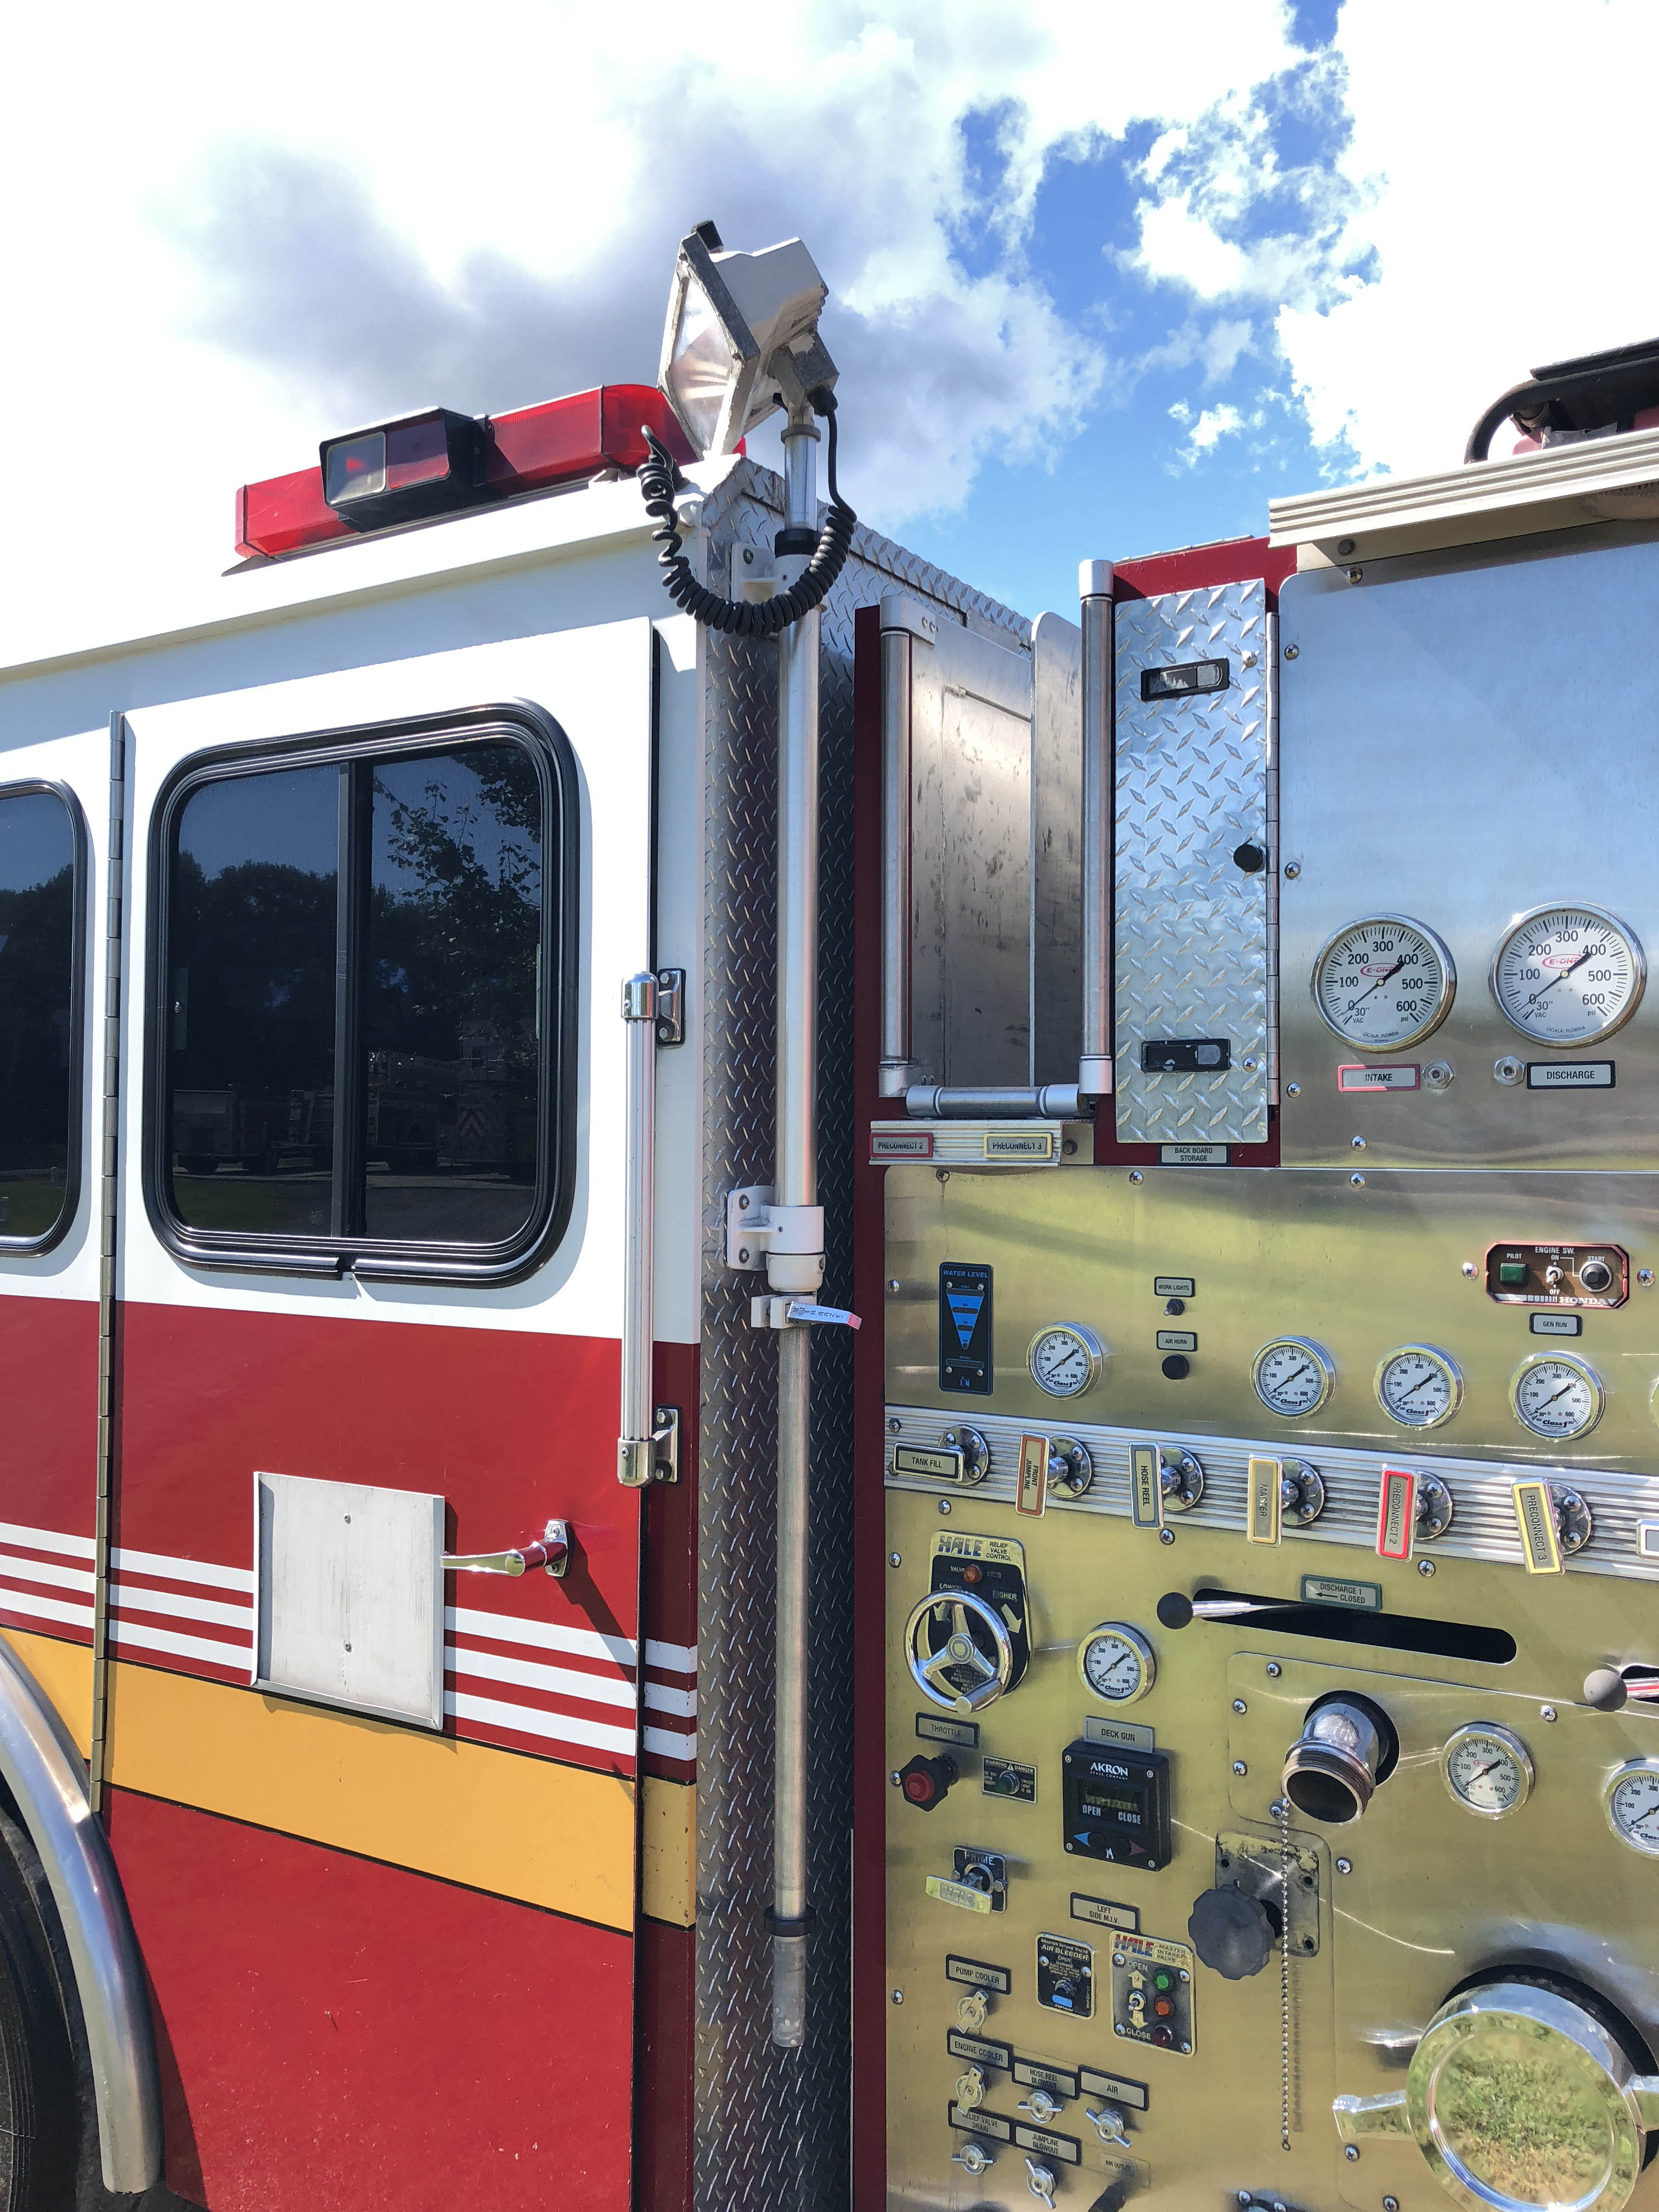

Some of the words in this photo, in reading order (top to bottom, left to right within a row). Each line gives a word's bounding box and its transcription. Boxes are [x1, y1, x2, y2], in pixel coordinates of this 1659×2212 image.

[1555, 930, 1578, 943] 300
[1372, 941, 1393, 952] 300
[1528, 944, 1551, 956] 200
[1583, 944, 1606, 956] 400
[1348, 953, 1369, 964] 200
[1397, 953, 1418, 965] 400
[1520, 969, 1540, 980] 100
[1588, 970, 1611, 982] 500
[1340, 977, 1358, 988] 100
[1402, 978, 1423, 989] 500
[1348, 1000, 1355, 1011] 0
[1529, 994, 1536, 1005] 0
[1582, 994, 1605, 1005] 600
[1396, 1001, 1417, 1012] 600
[1364, 1073, 1392, 1082] INTAKE
[1546, 1070, 1595, 1080] DISCHARGE
[1559, 1297, 1607, 1305] HONDA
[912, 1457, 928, 1466] TANK
[930, 1459, 942, 1468] FILL
[1141, 1465, 1149, 1486] HOSE
[1259, 1484, 1268, 1517] MASTER
[1390, 1483, 1401, 1537] PRECONNECT
[1527, 1496, 1545, 1550] PRECONNECT
[938, 1536, 983, 1556] HALE
[1320, 1583, 1357, 1594] DISCHARGE
[1340, 1594, 1365, 1604] CLOSED
[930, 1724, 962, 1737] THROTTLE
[1101, 1728, 1119, 1739] DECK
[1121, 1733, 1135, 1742] GUN
[985, 1759, 1007, 1768] WARNING
[1014, 1765, 1034, 1773] DANGER
[1090, 1762, 1128, 1776] AKRON
[1082, 1804, 1101, 1816] OPEN
[1118, 1812, 1141, 1825] CLOSE
[964, 1851, 995, 1865] PRIME
[1097, 1905, 1111, 1914] LEFT
[1089, 1911, 1102, 1920] SIDE
[1103, 1914, 1120, 1925] M.I.V.
[1114, 1934, 1154, 1957] HALE
[1159, 1944, 1186, 1954] MASTER
[1055, 1948, 1089, 1961] BLEEDER
[1156, 1954, 1177, 1963] VALVE
[1127, 1961, 1148, 1971] OPEN
[956, 1966, 973, 1977] PUMP
[975, 1972, 1000, 1984] COOLER
[1126, 2027, 1151, 2040] CLOSE
[955, 2041, 977, 2054] ENGINE
[979, 2049, 1003, 2062] COOLER
[1030, 2069, 1045, 2078] HOSE
[1045, 2073, 1058, 2082] REEL
[1107, 2085, 1119, 2095] AIR
[972, 2122, 989, 2132] DRAIN
[981, 2117, 998, 2128] VALVE
[1032, 2134, 1059, 2147] JUMPLINE
[1032, 2143, 1059, 2155] BLOWOUT
